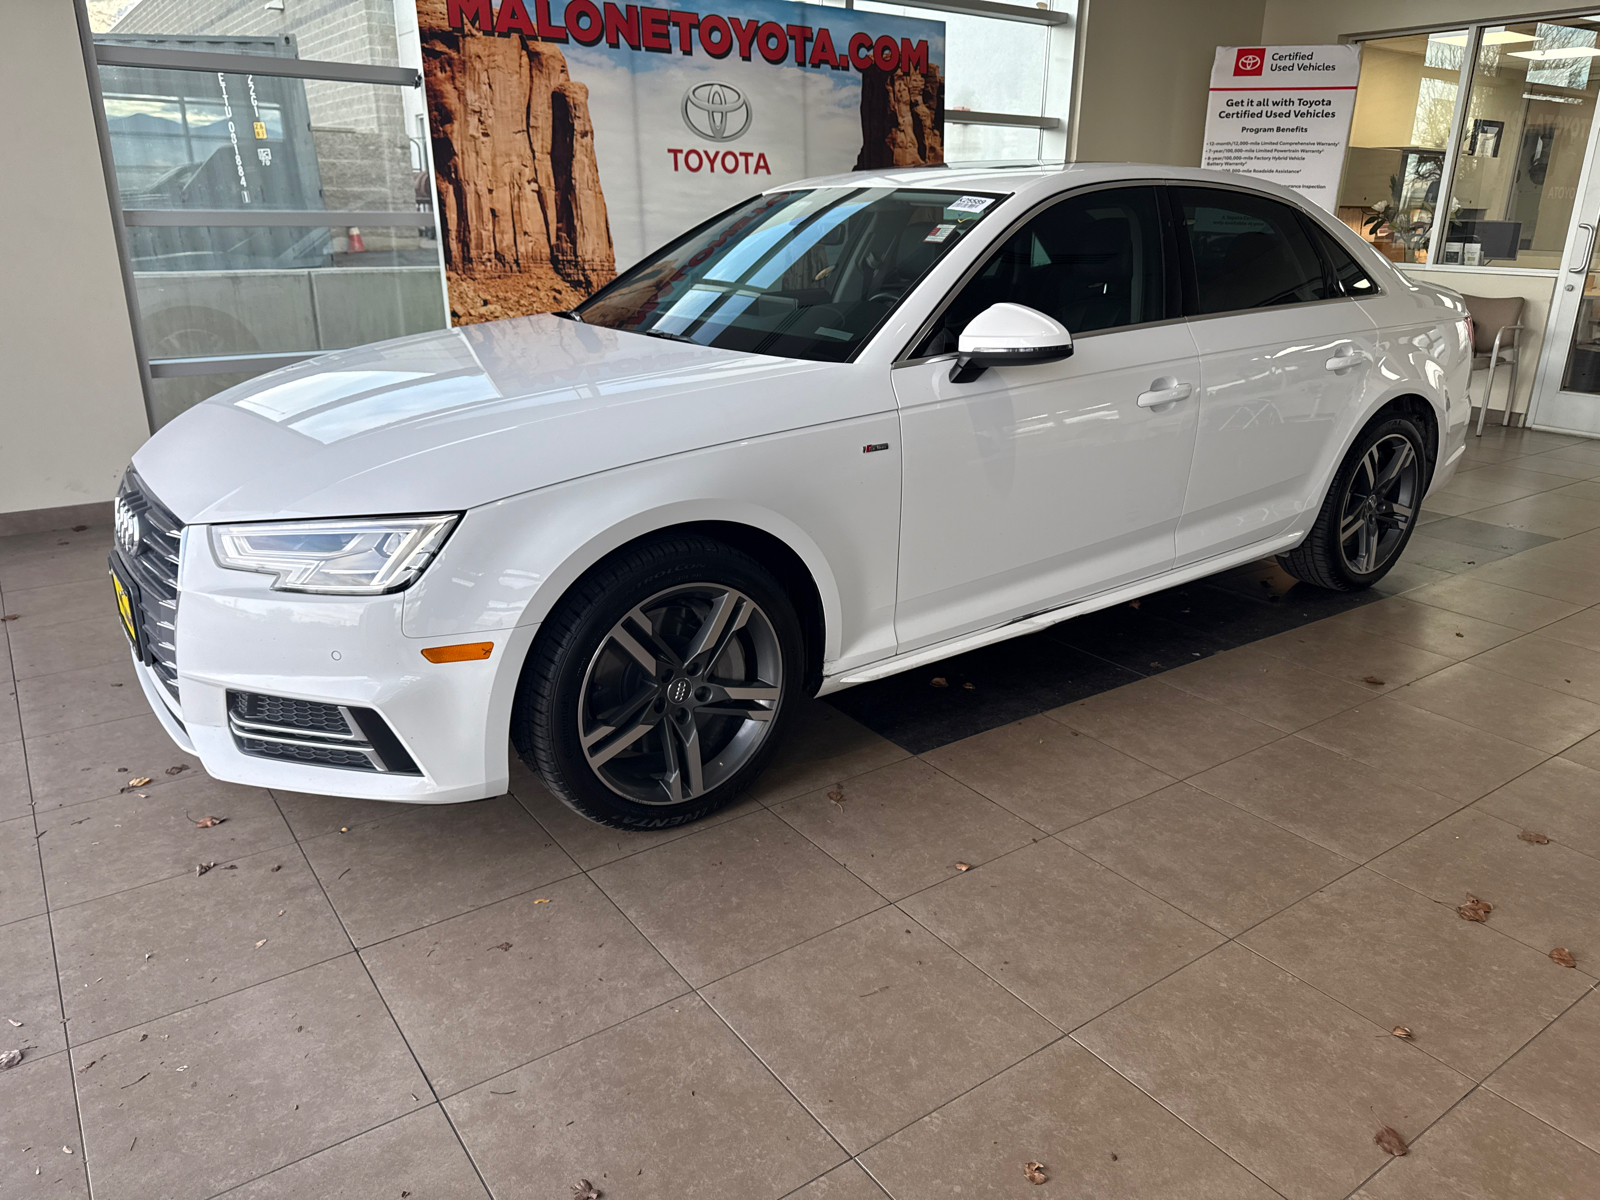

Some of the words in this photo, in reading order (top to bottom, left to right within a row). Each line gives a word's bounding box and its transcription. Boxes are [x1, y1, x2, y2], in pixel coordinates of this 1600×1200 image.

[447, 0, 929, 75] MALONETOYOTA.COM
[1271, 52, 1313, 61] Certified
[1270, 63, 1294, 71] Used
[1297, 62, 1336, 71] Vehicles
[1226, 99, 1245, 107] Get
[1246, 98, 1254, 107] it
[1256, 98, 1269, 107] all
[1271, 98, 1295, 107] with
[1297, 98, 1332, 108] Toyota
[1218, 110, 1263, 119] Certified
[1265, 109, 1291, 118] Used
[1293, 109, 1336, 118] Vehicles
[1241, 126, 1274, 134] Program
[667, 148, 771, 175] TOYOTA
